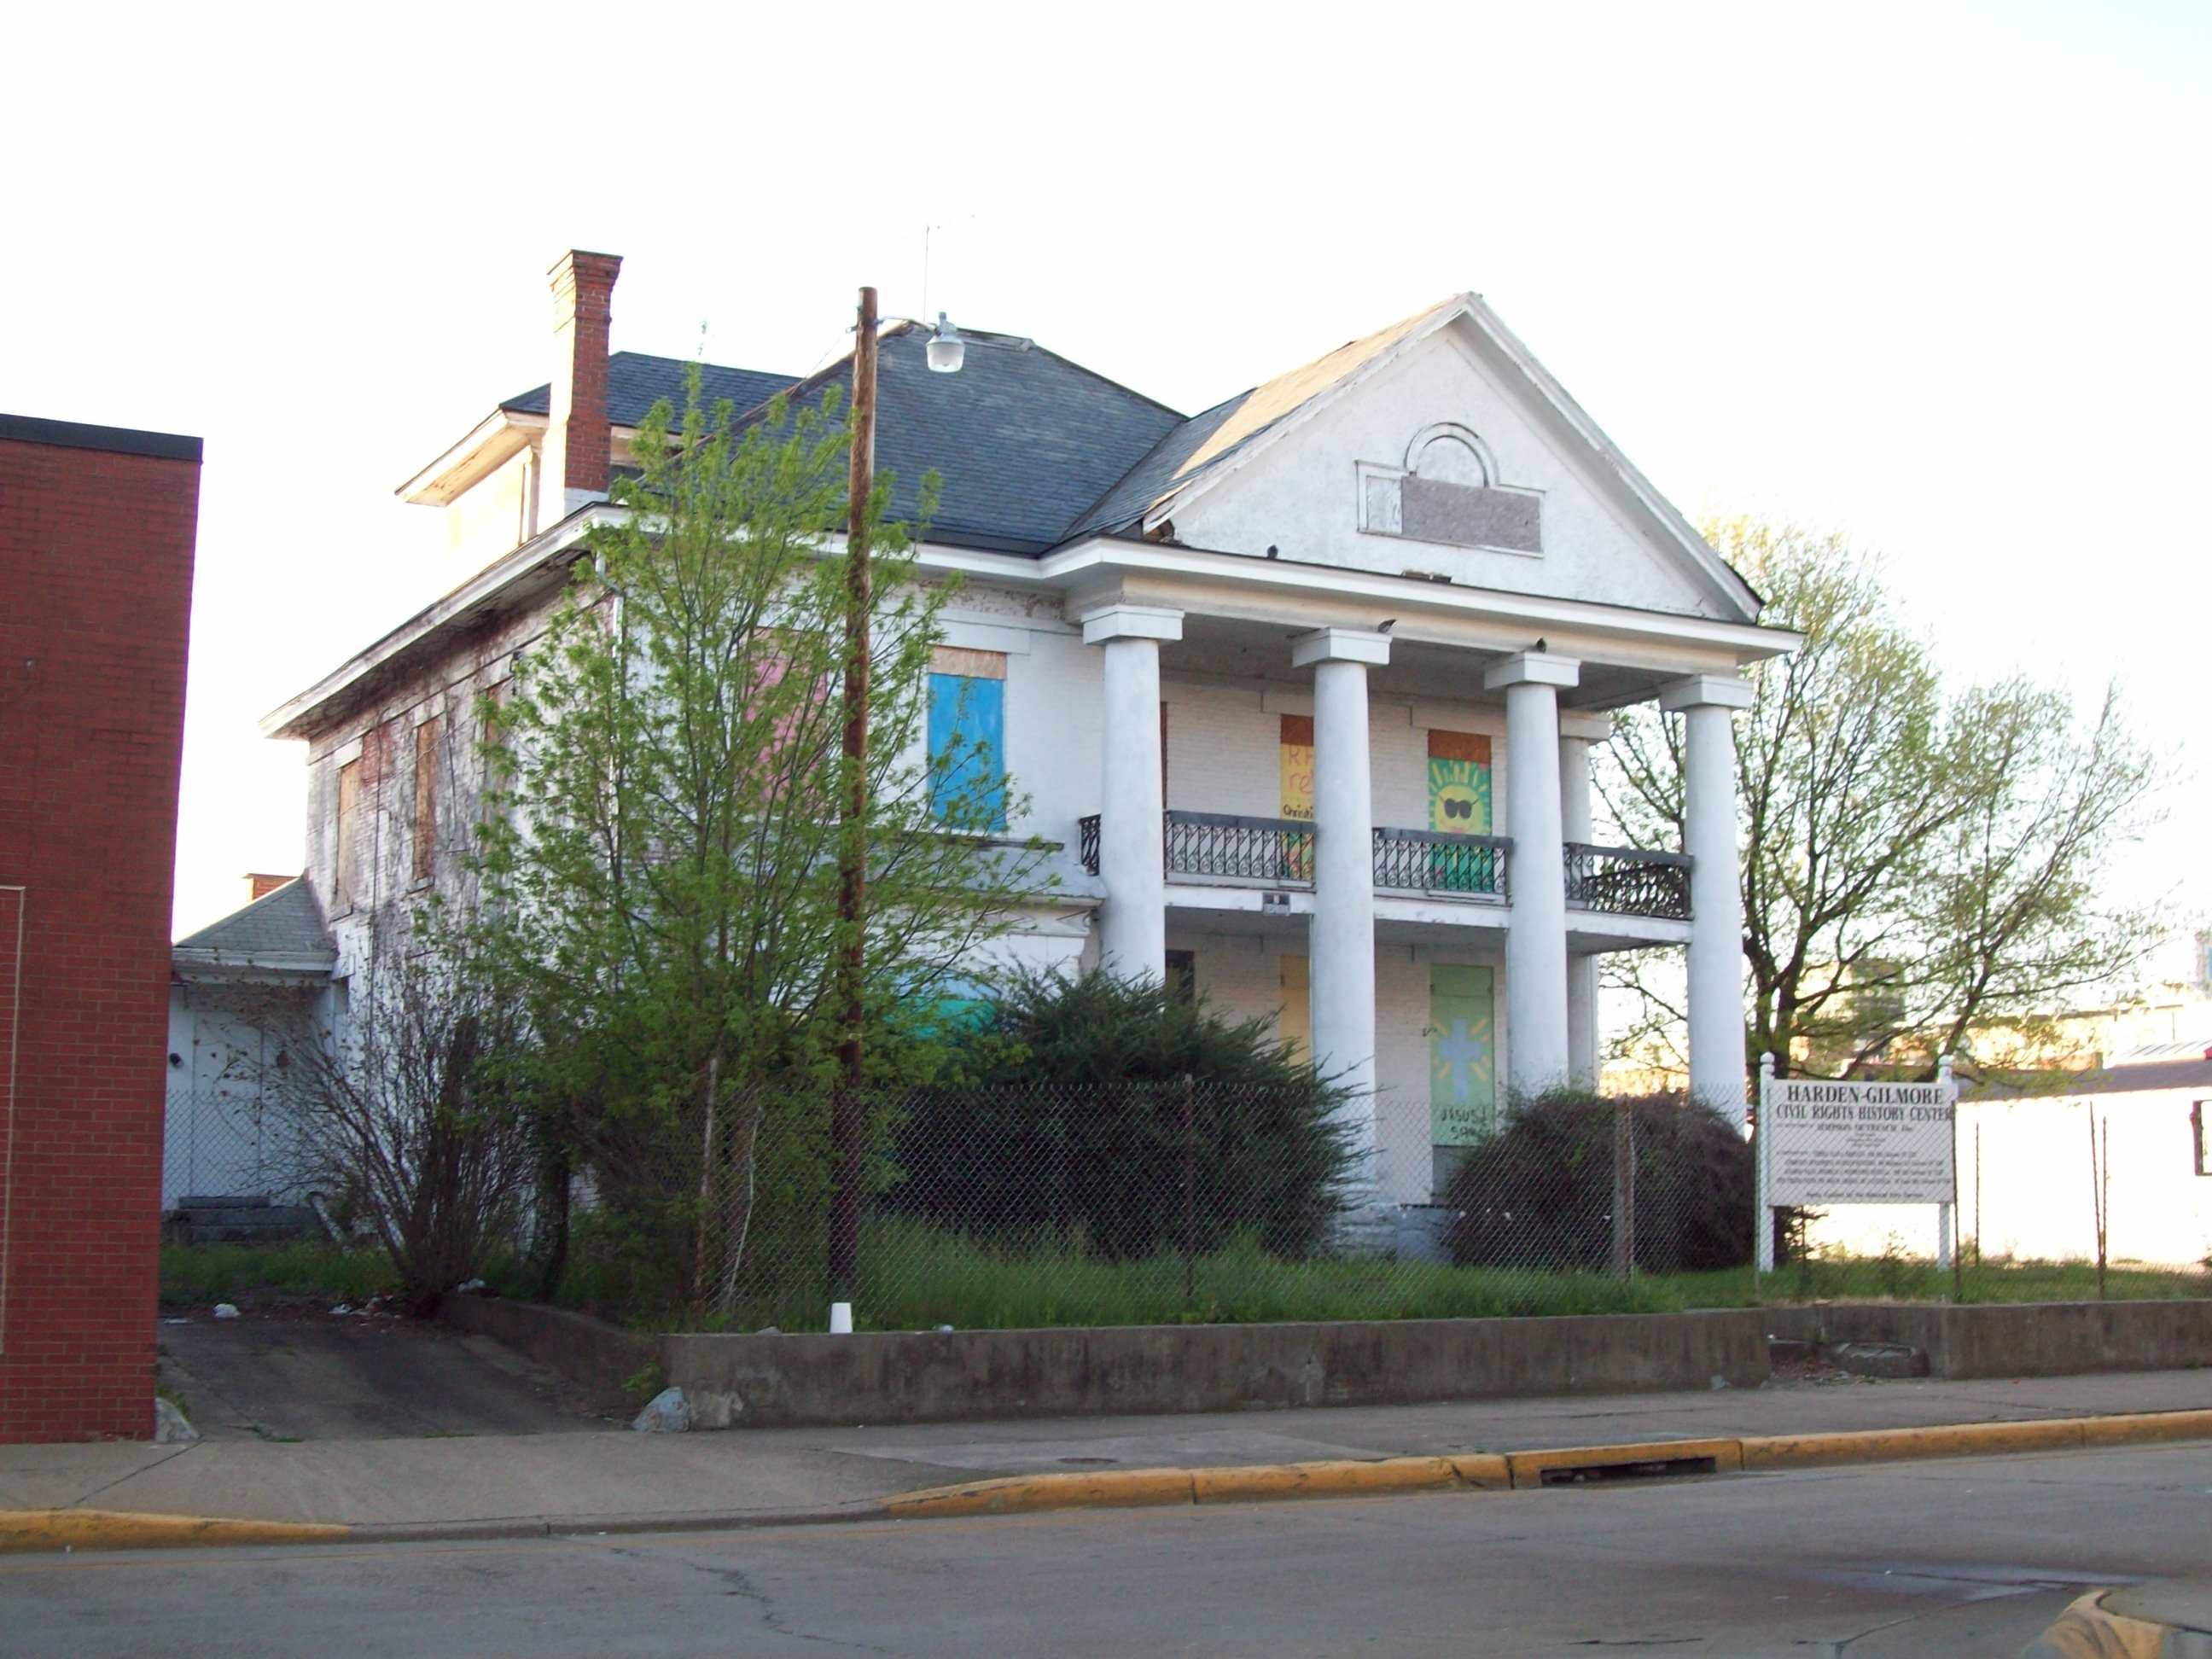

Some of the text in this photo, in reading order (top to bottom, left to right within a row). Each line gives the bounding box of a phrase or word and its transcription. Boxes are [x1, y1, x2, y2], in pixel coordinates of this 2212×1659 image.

[1787, 1085, 1944, 1104] HARDEN-GILMORE
[1777, 1104, 1952, 1121] CIVIL RIGHTS HISTORY CENTER
